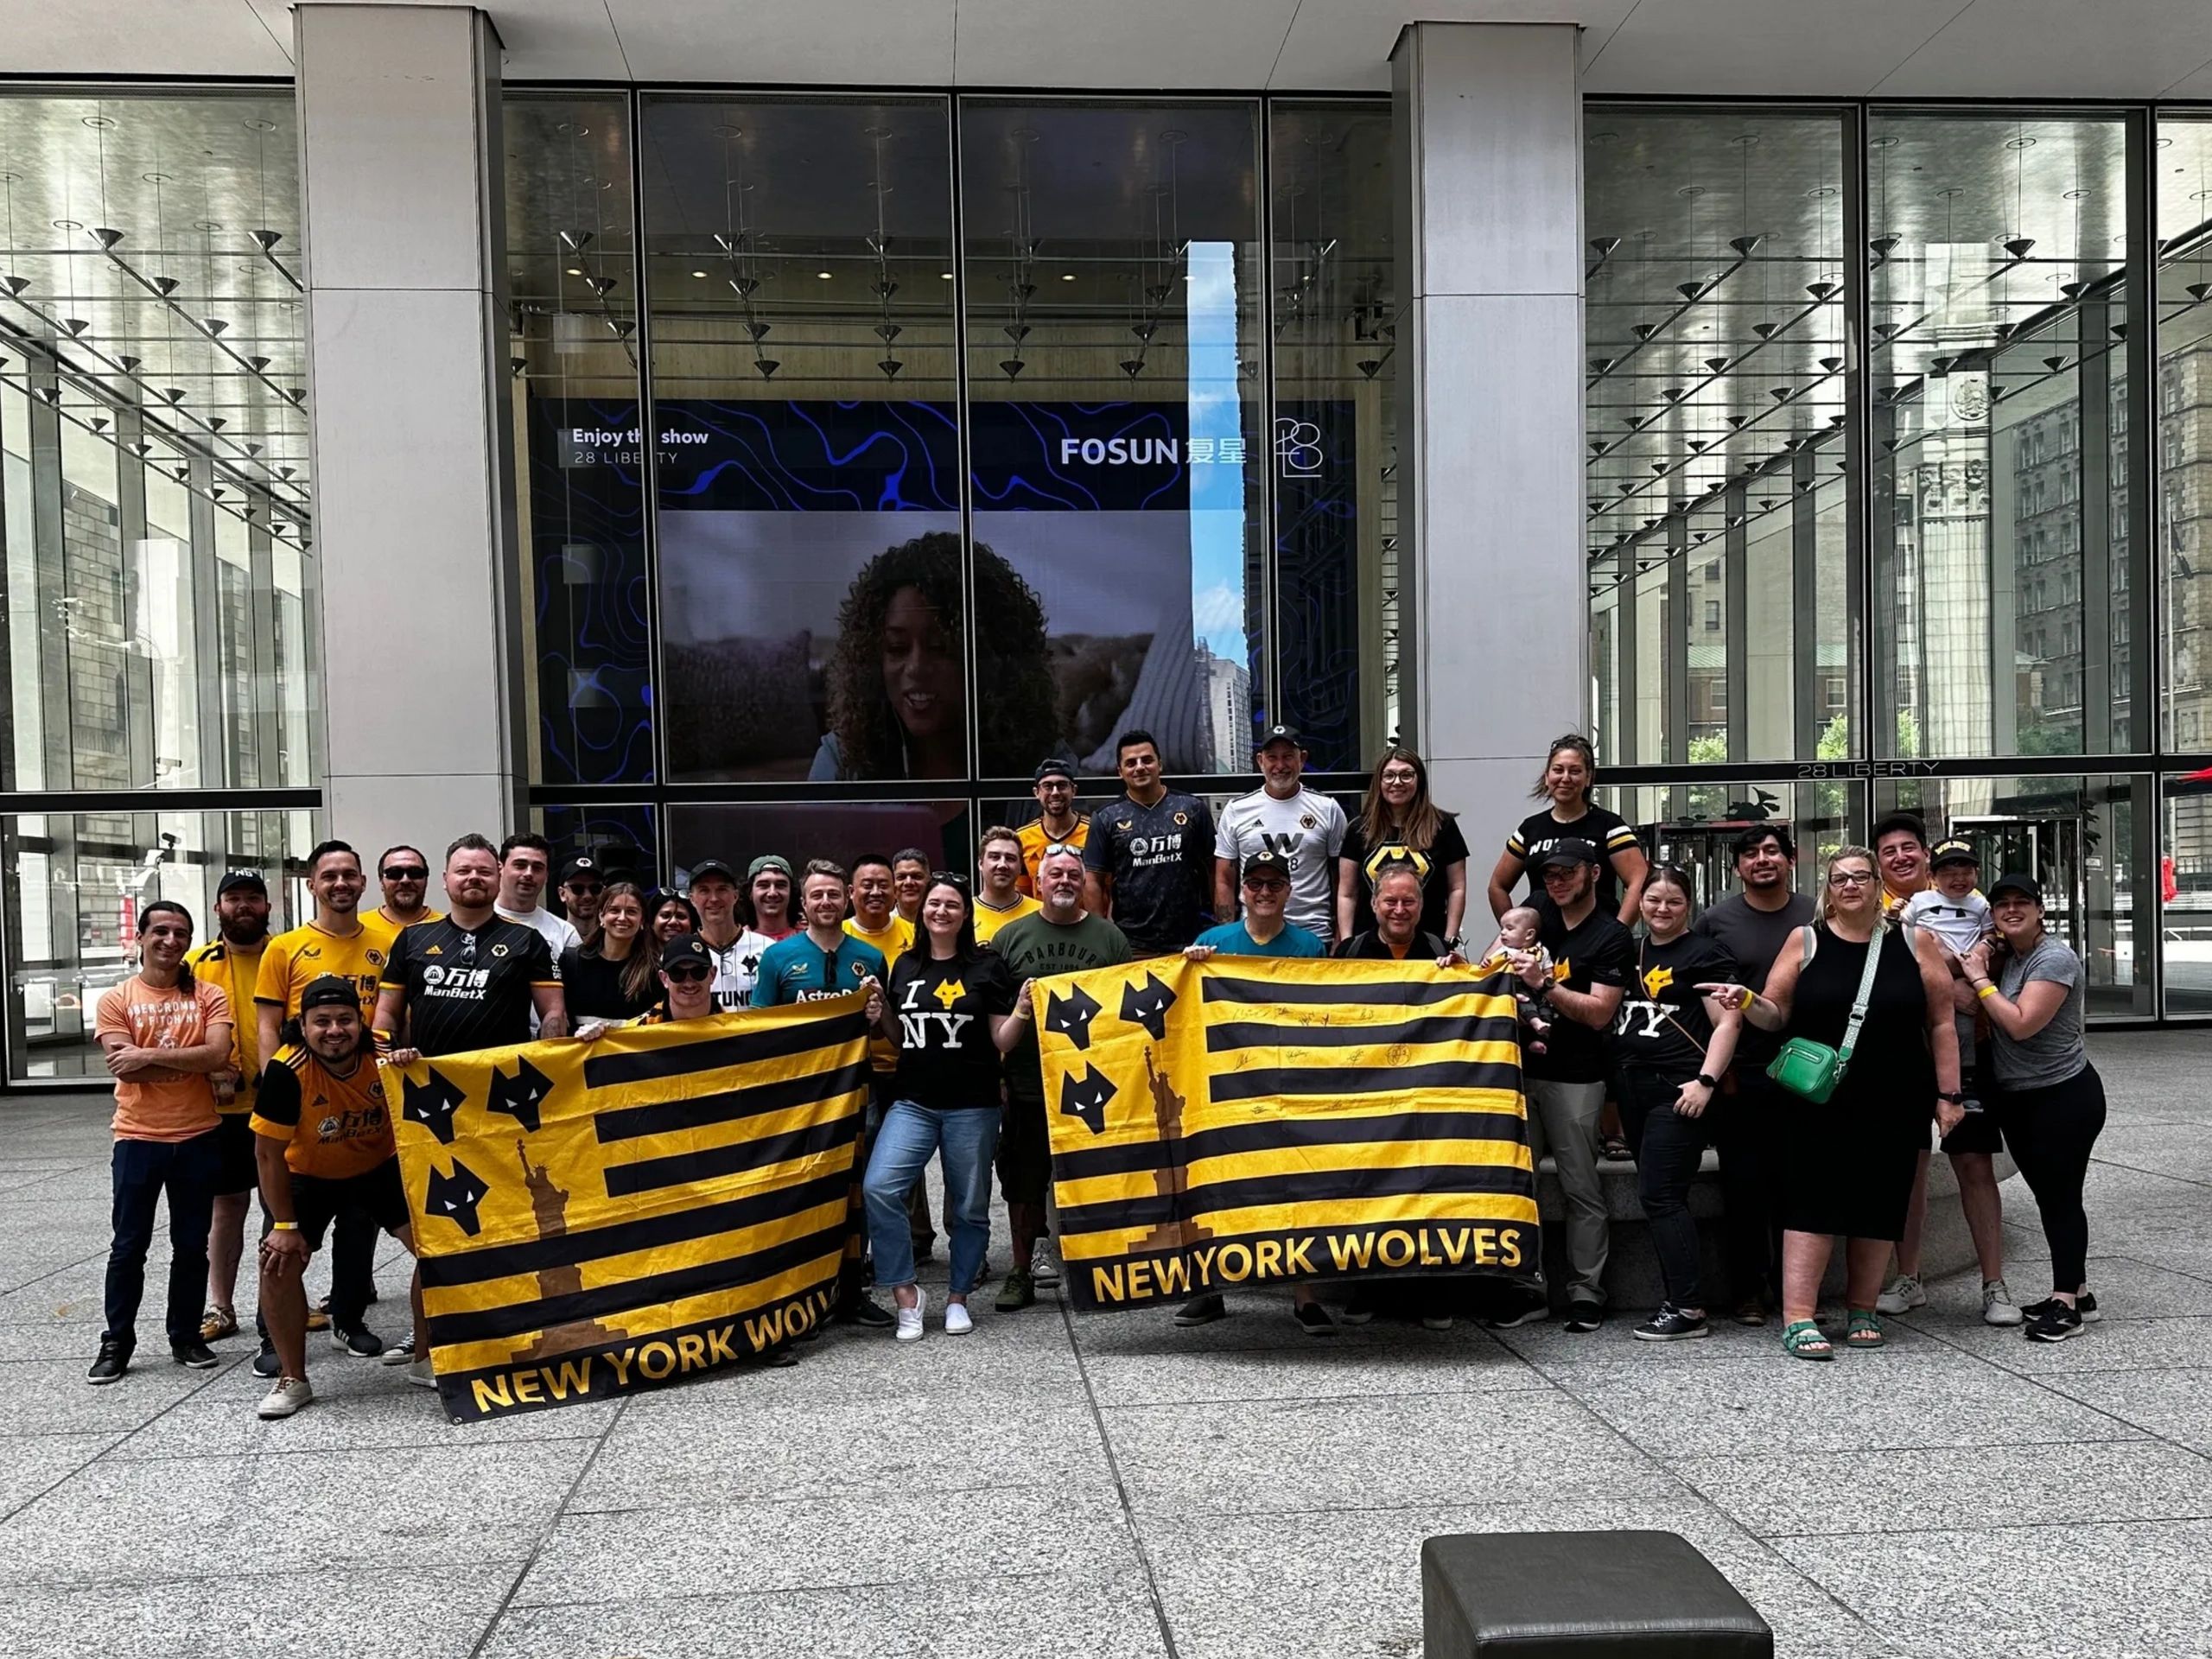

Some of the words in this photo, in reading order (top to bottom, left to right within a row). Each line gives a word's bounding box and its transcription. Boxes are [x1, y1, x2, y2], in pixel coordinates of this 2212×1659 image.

[573, 429, 623, 447] Enjoy
[626, 429, 642, 443] th
[661, 429, 709, 444] show
[575, 451, 596, 464] 28
[604, 451, 677, 464] LIBETY
[1061, 438, 1178, 465] FOSUN
[1186, 438, 1247, 464] 复星
[1797, 764, 1827, 778] 28
[1833, 761, 1940, 777] LIBERTY
[1150, 834, 1182, 853] 万博
[1133, 852, 1183, 868] ManBetX
[1025, 942, 1096, 966] BARBOUR
[444, 968, 490, 988] 万博
[424, 985, 486, 1000] ManBetX
[900, 980, 926, 1010] I
[899, 1012, 974, 1048] NY
[1092, 1254, 1192, 1303] NEW
[1193, 1236, 1319, 1286] YORK
[1326, 1228, 1522, 1271] WOLVES
[471, 1357, 592, 1413] NEW
[603, 1324, 739, 1385] YORK
